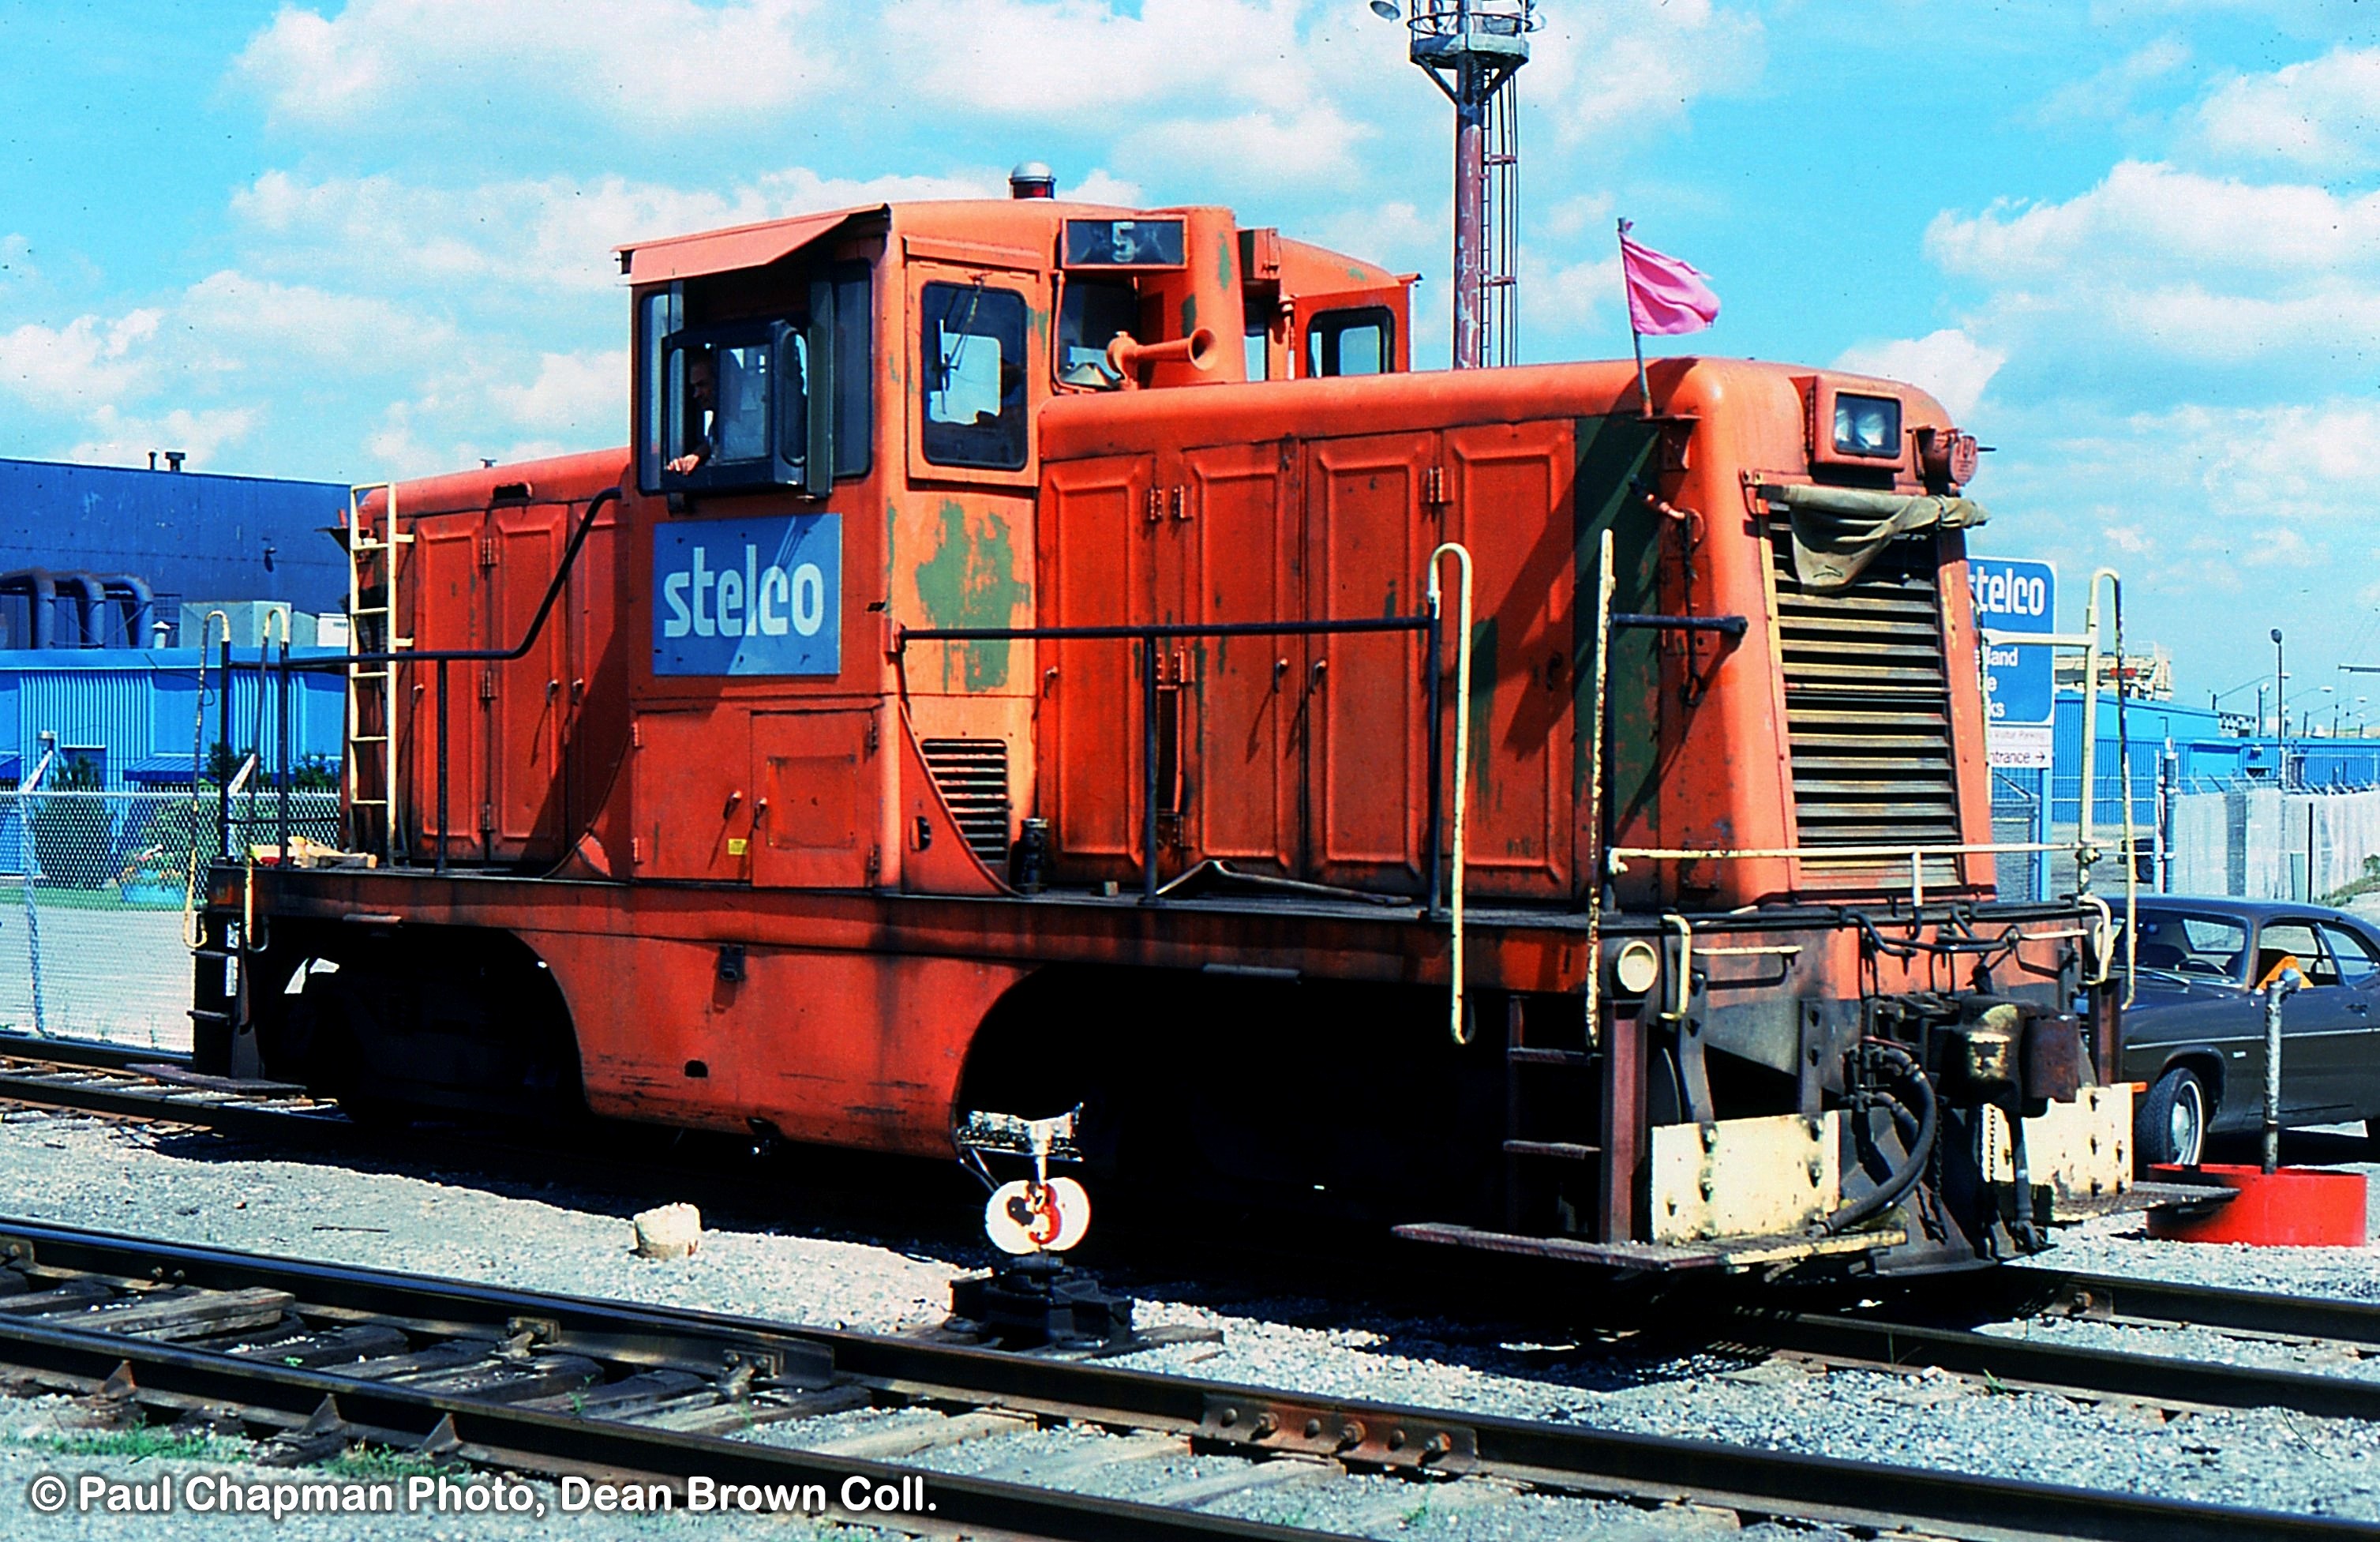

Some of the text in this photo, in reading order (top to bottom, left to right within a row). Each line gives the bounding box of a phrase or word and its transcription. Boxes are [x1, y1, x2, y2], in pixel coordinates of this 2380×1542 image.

[1111, 221, 1135, 262] 5
[664, 545, 824, 637] stelco
[1989, 751, 2030, 764] ntrance
